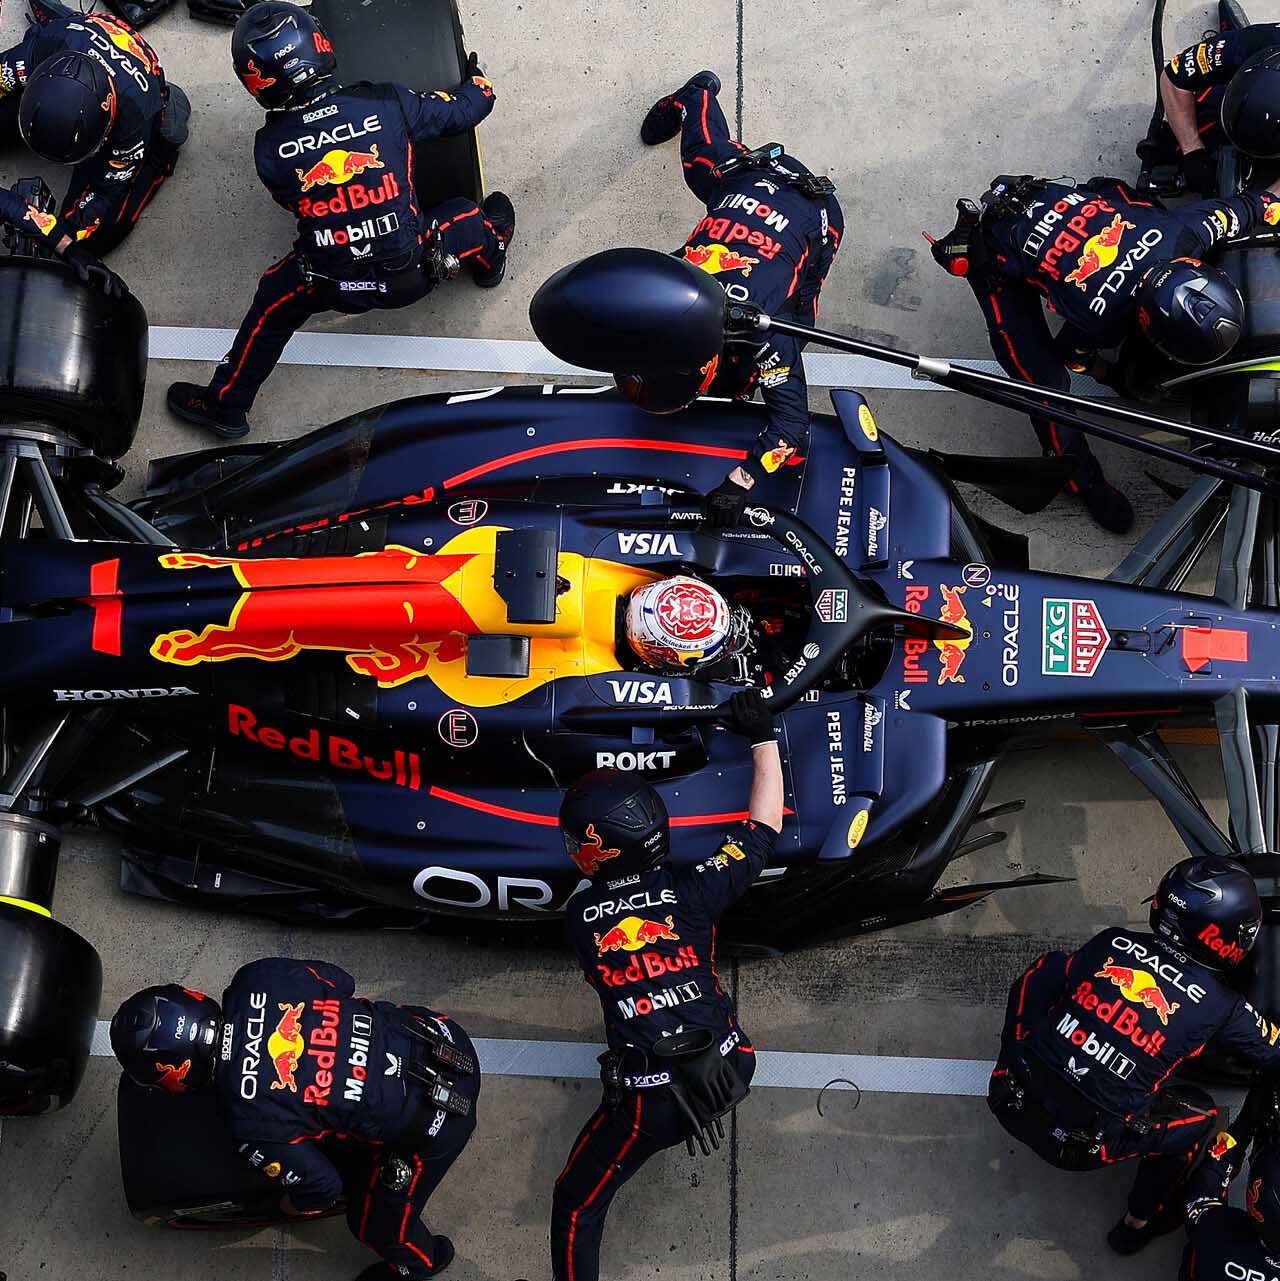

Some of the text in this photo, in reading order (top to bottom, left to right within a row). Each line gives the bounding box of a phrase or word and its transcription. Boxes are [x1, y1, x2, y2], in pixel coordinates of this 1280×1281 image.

[66, 22, 149, 92] ORACLE
[1184, 47, 1196, 77] VISA
[302, 104, 339, 124] sparco
[278, 114, 382, 160] ORACLE
[298, 171, 399, 218] Red Bull
[730, 193, 791, 233] Mobil
[1034, 192, 1087, 237] Mobil
[1066, 194, 1117, 238] Red
[314, 219, 376, 248] Mobil
[723, 221, 783, 261] Red
[1089, 228, 1163, 317] ORACLE
[835, 467, 856, 557] PEPE JEANS
[618, 532, 684, 556] VISA
[785, 530, 823, 576] ORACLE
[820, 592, 832, 621] HEUER
[835, 593, 845, 620] TAG
[660, 635, 692, 649] Heineken
[903, 586, 930, 683] Re Bull
[1002, 584, 1020, 687] ORACLE
[1048, 605, 1068, 669] TAG
[1076, 604, 1103, 673] HEUER
[606, 680, 673, 704] VISA
[783, 656, 808, 686] AT&T
[53, 686, 200, 701] HONDA
[227, 703, 422, 791] Red Bull
[596, 751, 677, 771] ROKT
[827, 711, 847, 806] PEPE JEANS
[583, 888, 678, 923] ORACLE
[596, 945, 701, 989] Red Bull
[1111, 936, 1209, 1004] ORACLE
[617, 985, 680, 1021] Mobil
[1072, 980, 1123, 1024] Red
[221, 1022, 235, 1062] sparco
[240, 991, 268, 1101] ORACLE
[303, 998, 343, 1107] Red Bull
[1056, 1012, 1116, 1065] Mobil
[343, 1034, 371, 1102] Mobil
[428, 1109, 447, 1137] spa
